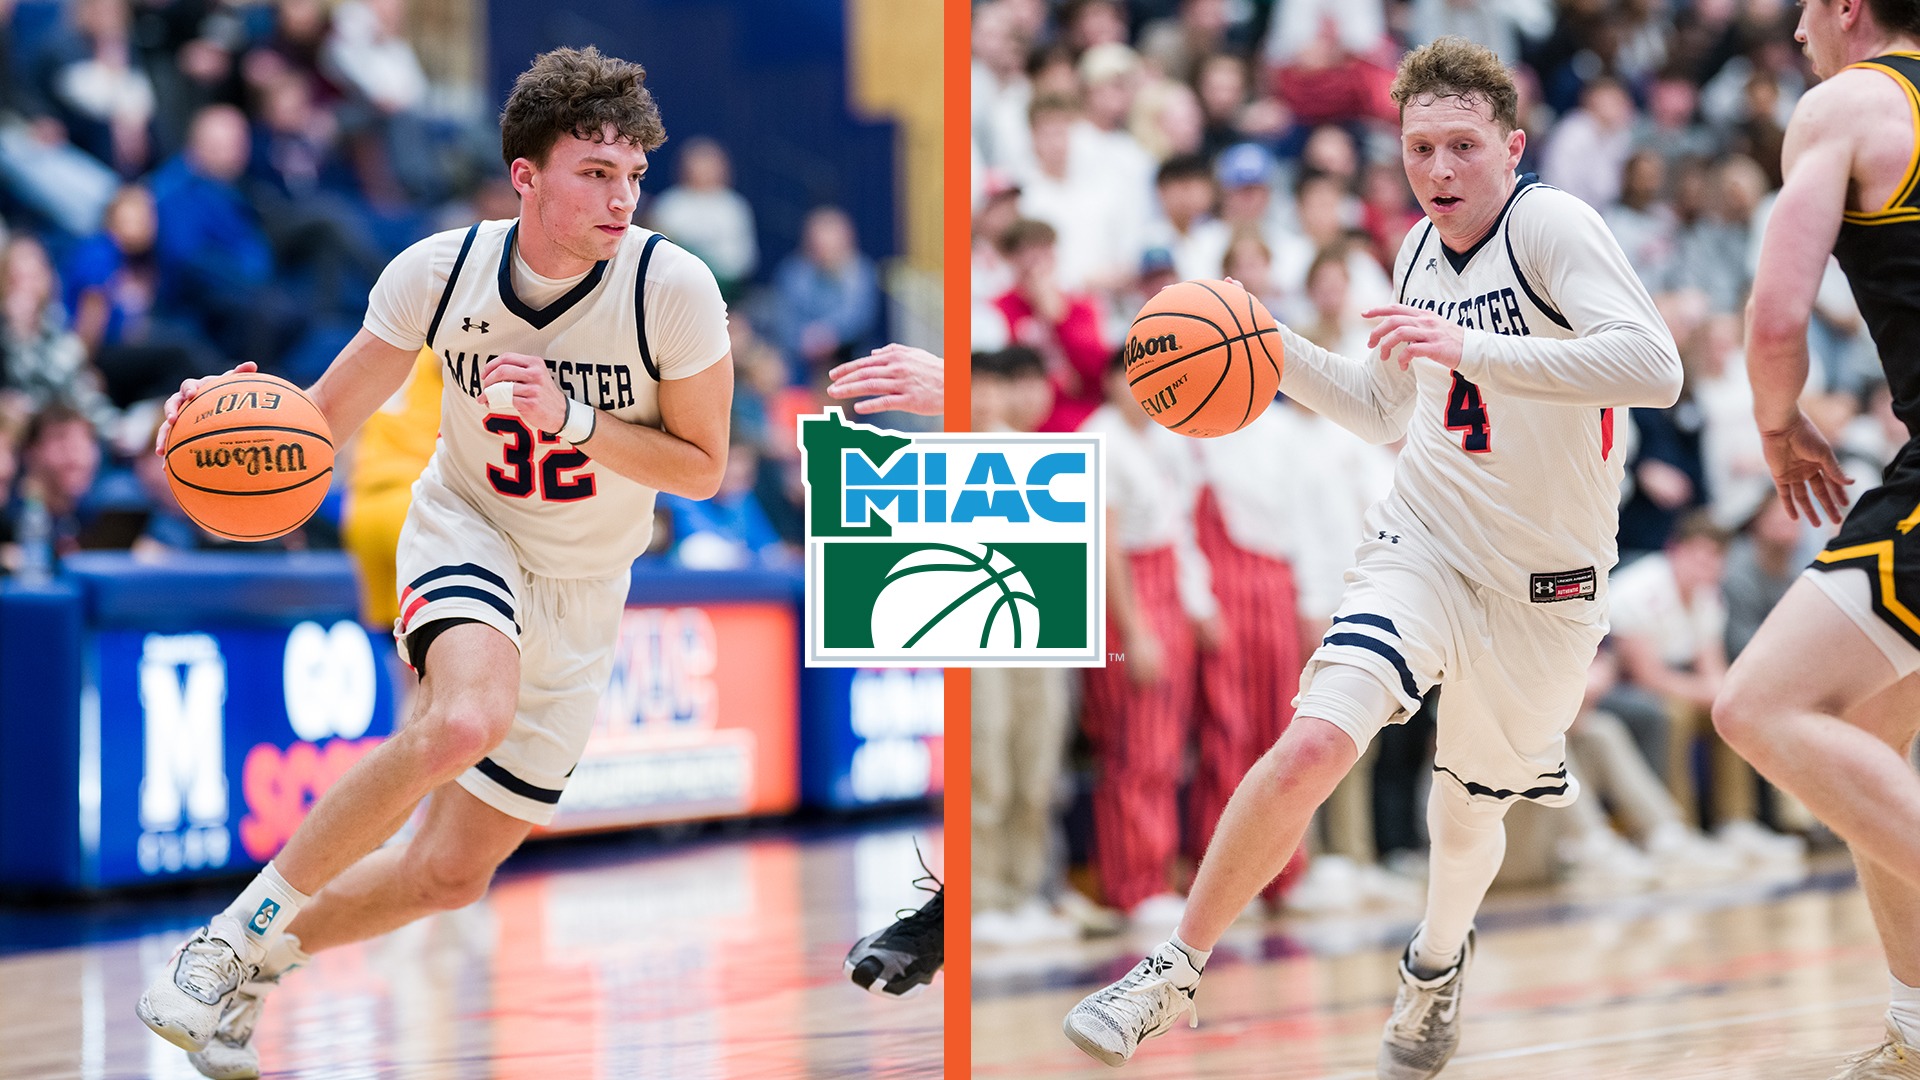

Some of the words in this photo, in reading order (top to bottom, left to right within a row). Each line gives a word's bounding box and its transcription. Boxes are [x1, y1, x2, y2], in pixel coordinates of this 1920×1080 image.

[1406, 287, 1530, 335] ESTER
[445, 349, 635, 411] MASTER
[1123, 334, 1178, 373] ilson
[1444, 368, 1492, 454] 4
[194, 443, 307, 476] Wilson
[482, 412, 597, 503] 32
